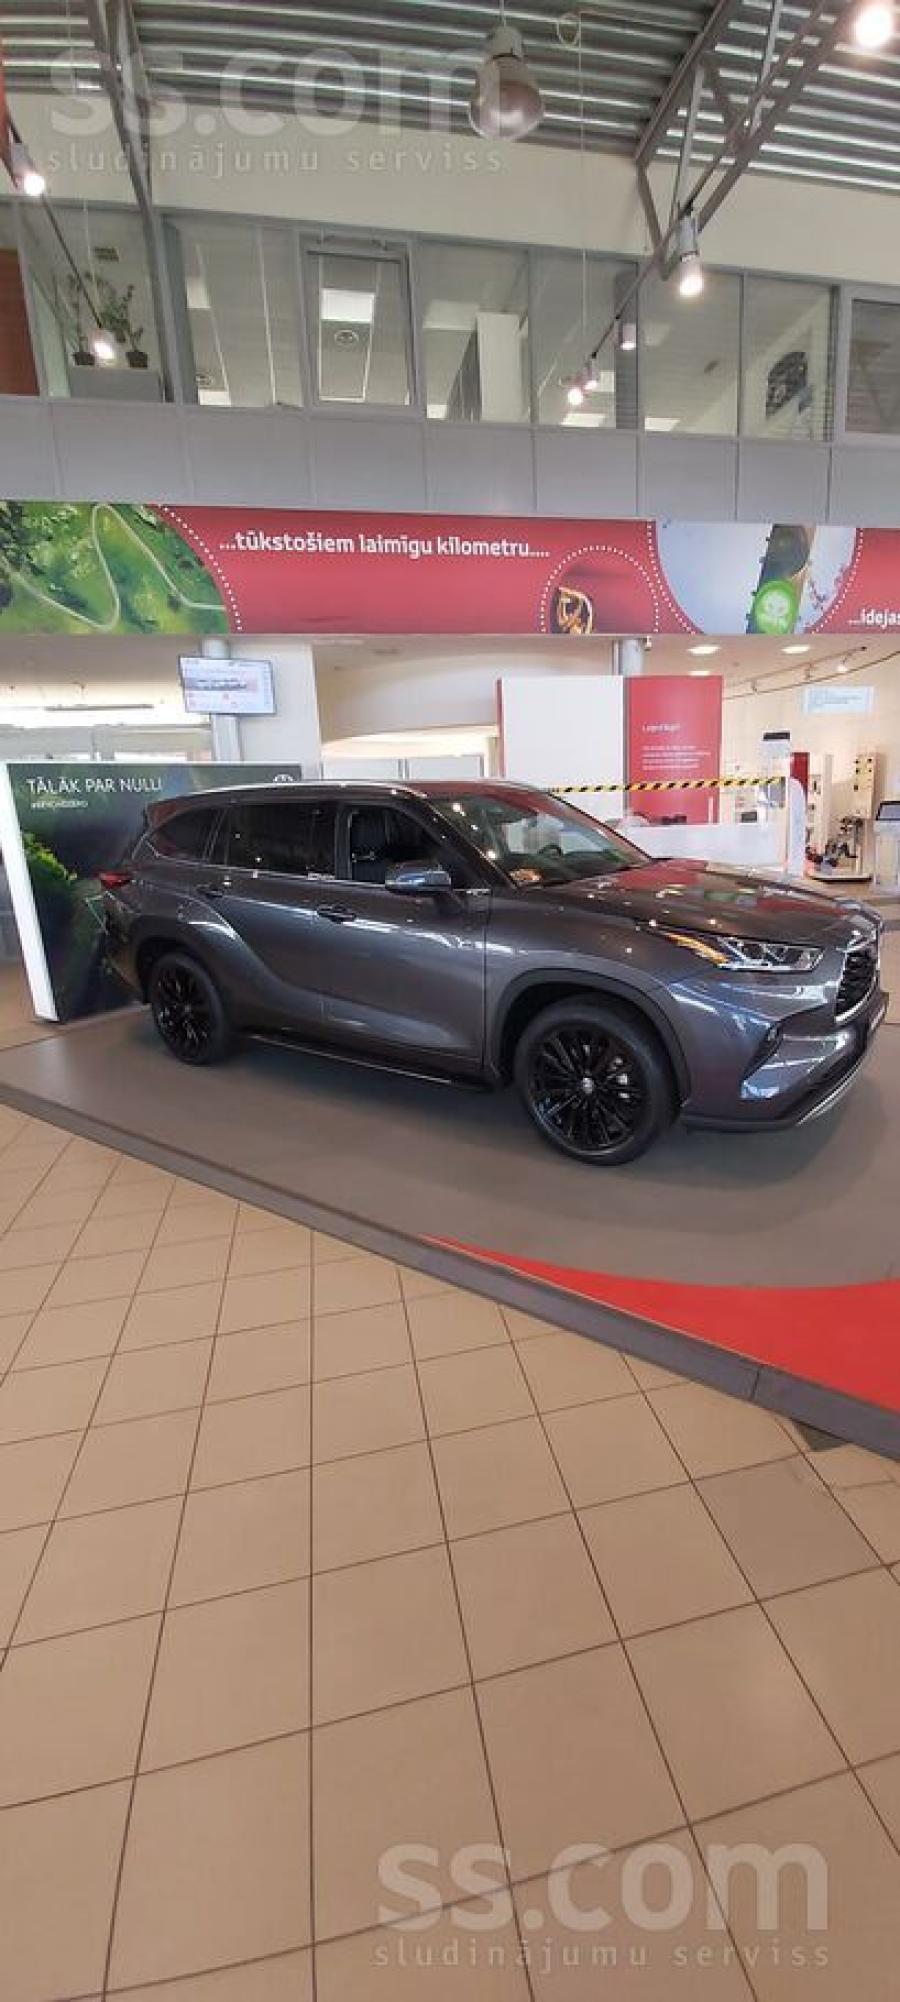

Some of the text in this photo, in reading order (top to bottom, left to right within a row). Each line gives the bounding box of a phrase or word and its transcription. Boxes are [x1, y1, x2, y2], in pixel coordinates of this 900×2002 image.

[358, 534, 432, 560] laimīgu
[26, 776, 162, 795] TĀLĀK PAR NULLI
